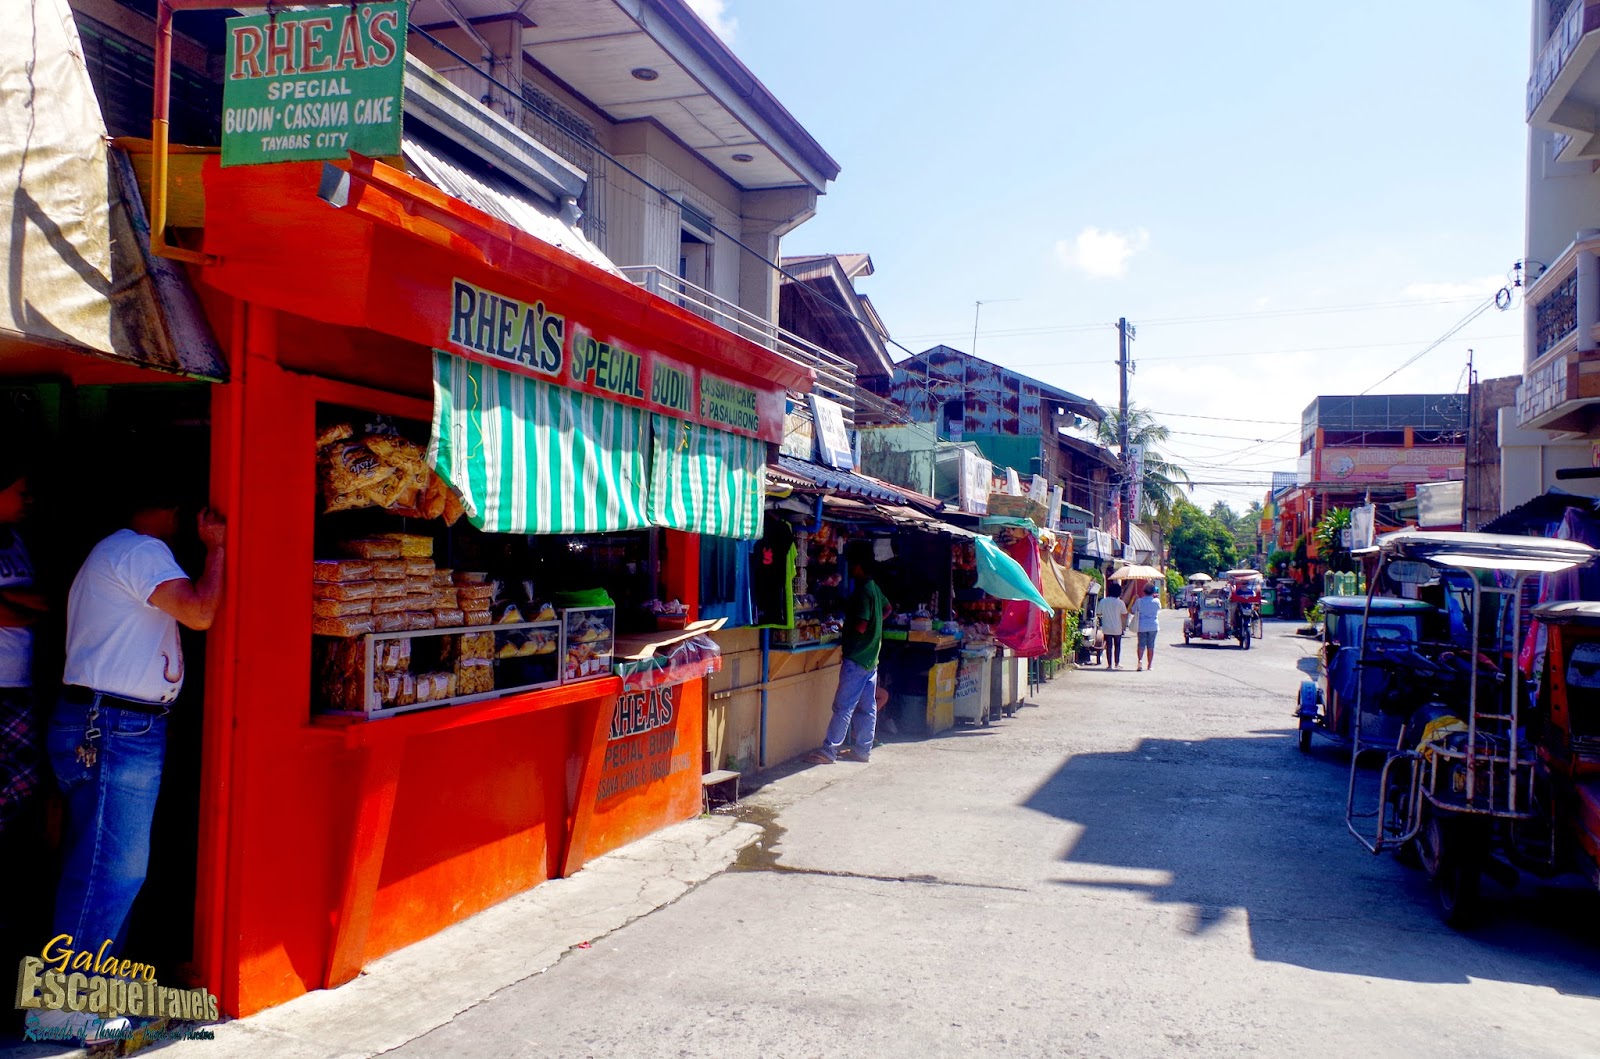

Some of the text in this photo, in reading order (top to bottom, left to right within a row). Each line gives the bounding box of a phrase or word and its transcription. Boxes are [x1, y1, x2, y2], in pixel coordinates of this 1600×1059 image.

[230, 7, 398, 80] RHEA'S
[268, 78, 351, 100] SPECIAL
[225, 96, 394, 134] BUDIN CASSAVA CAKE
[261, 132, 349, 152] TAYABAS CITY
[452, 280, 757, 413] RHEA'S SPECIAL BUDIN CASSAVA CAKE
[709, 400, 760, 433] PASALUBONG
[649, 730, 680, 755] BUDIN
